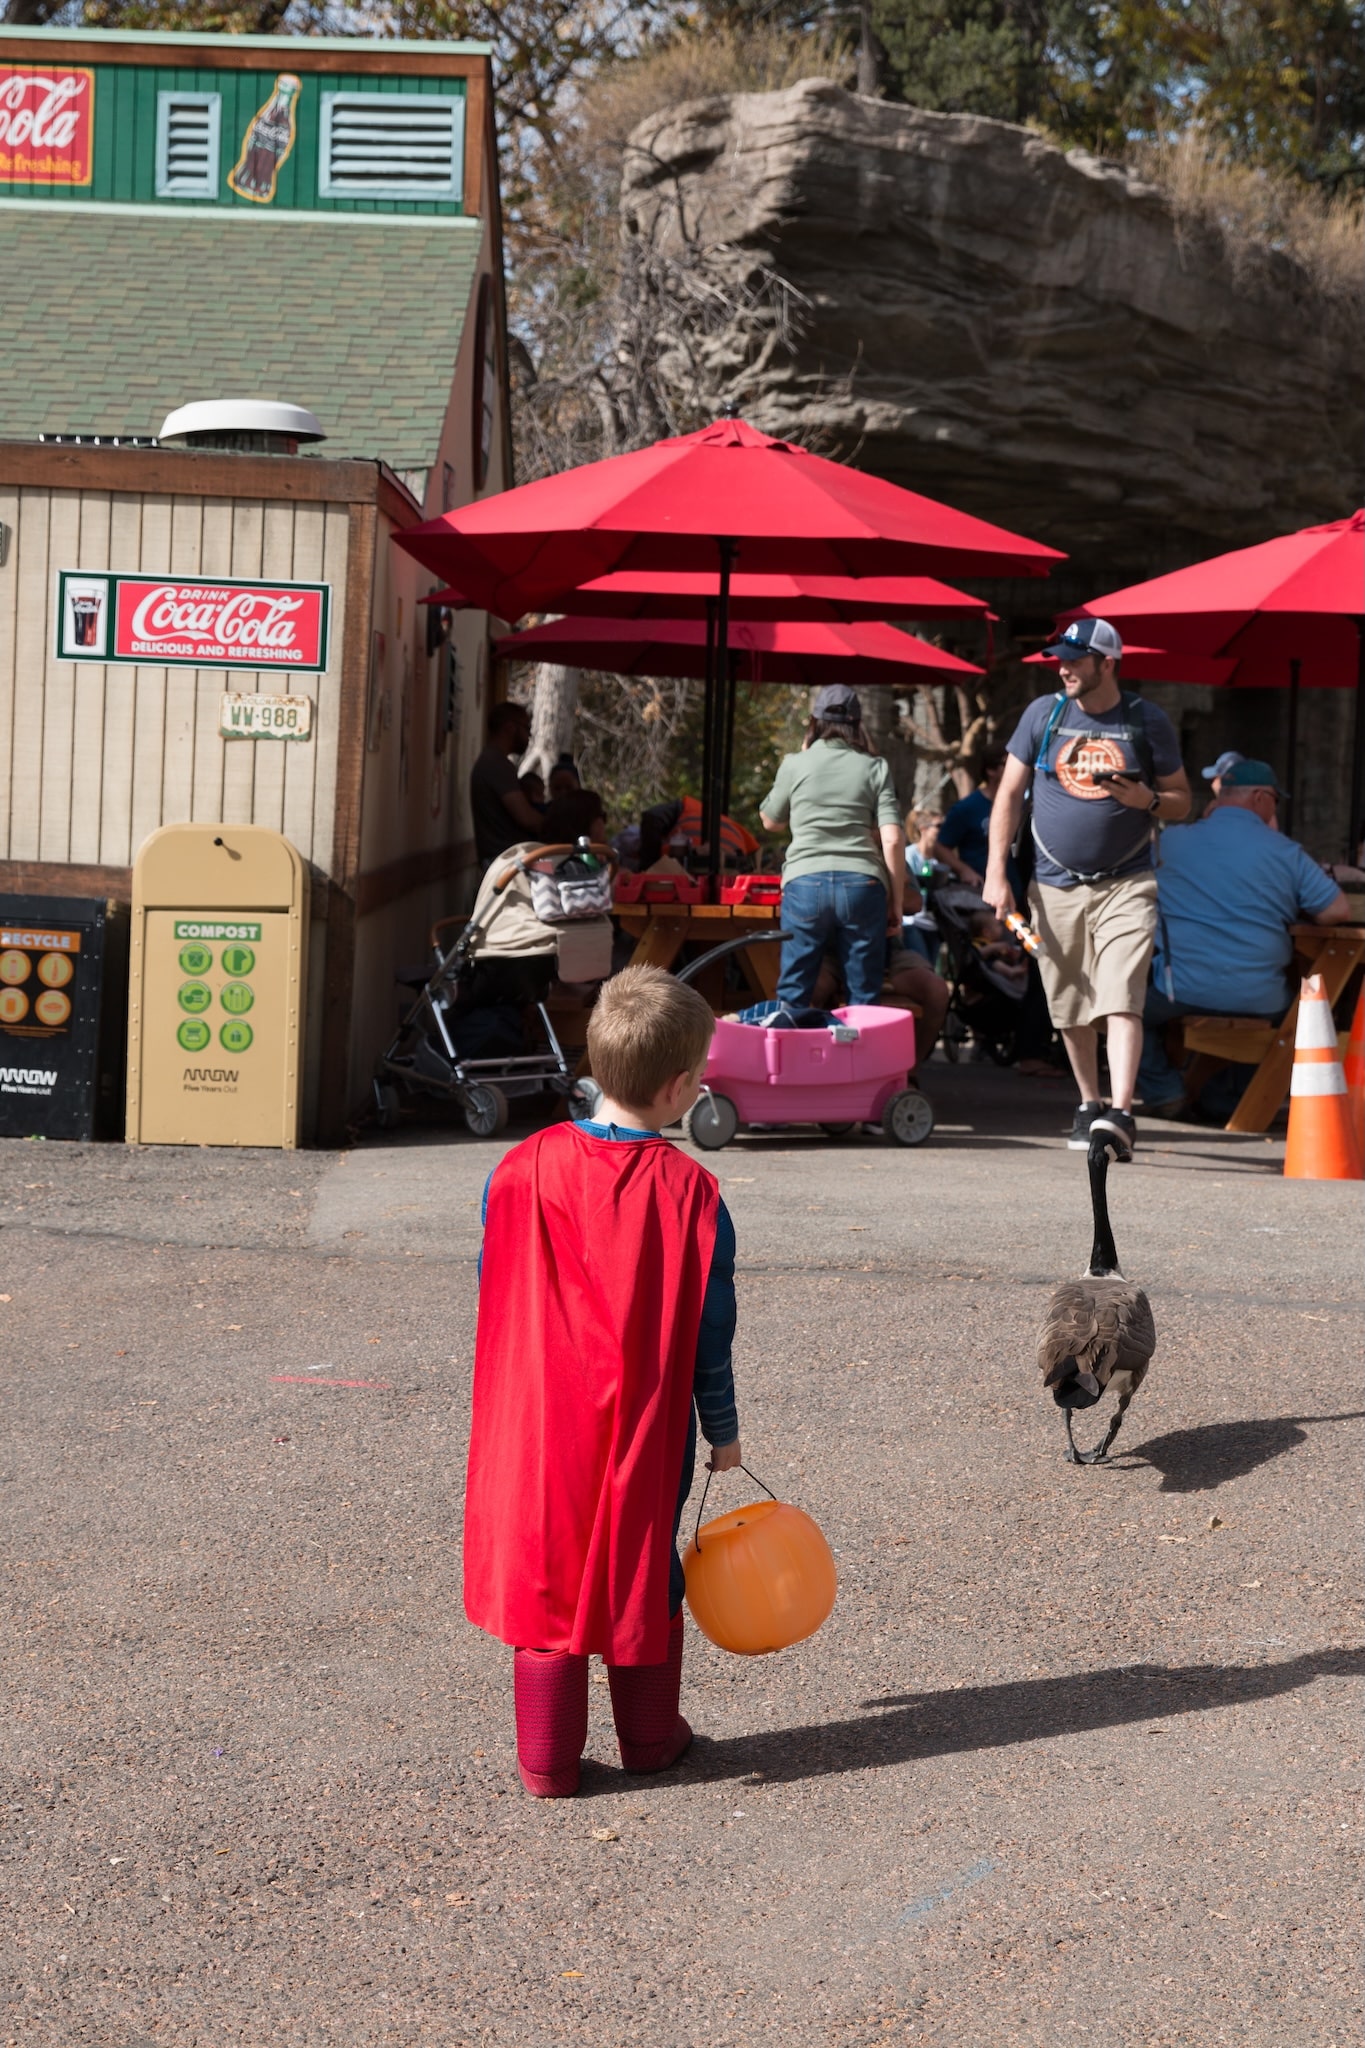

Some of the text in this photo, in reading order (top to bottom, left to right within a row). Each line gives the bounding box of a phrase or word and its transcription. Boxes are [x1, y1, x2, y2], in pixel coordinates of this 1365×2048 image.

[178, 588, 231, 602] DRINK
[131, 641, 304, 661] DELICIOUS AND REFRESHING
[177, 924, 259, 940] COMPOST
[1, 932, 71, 949] RECYCLE
